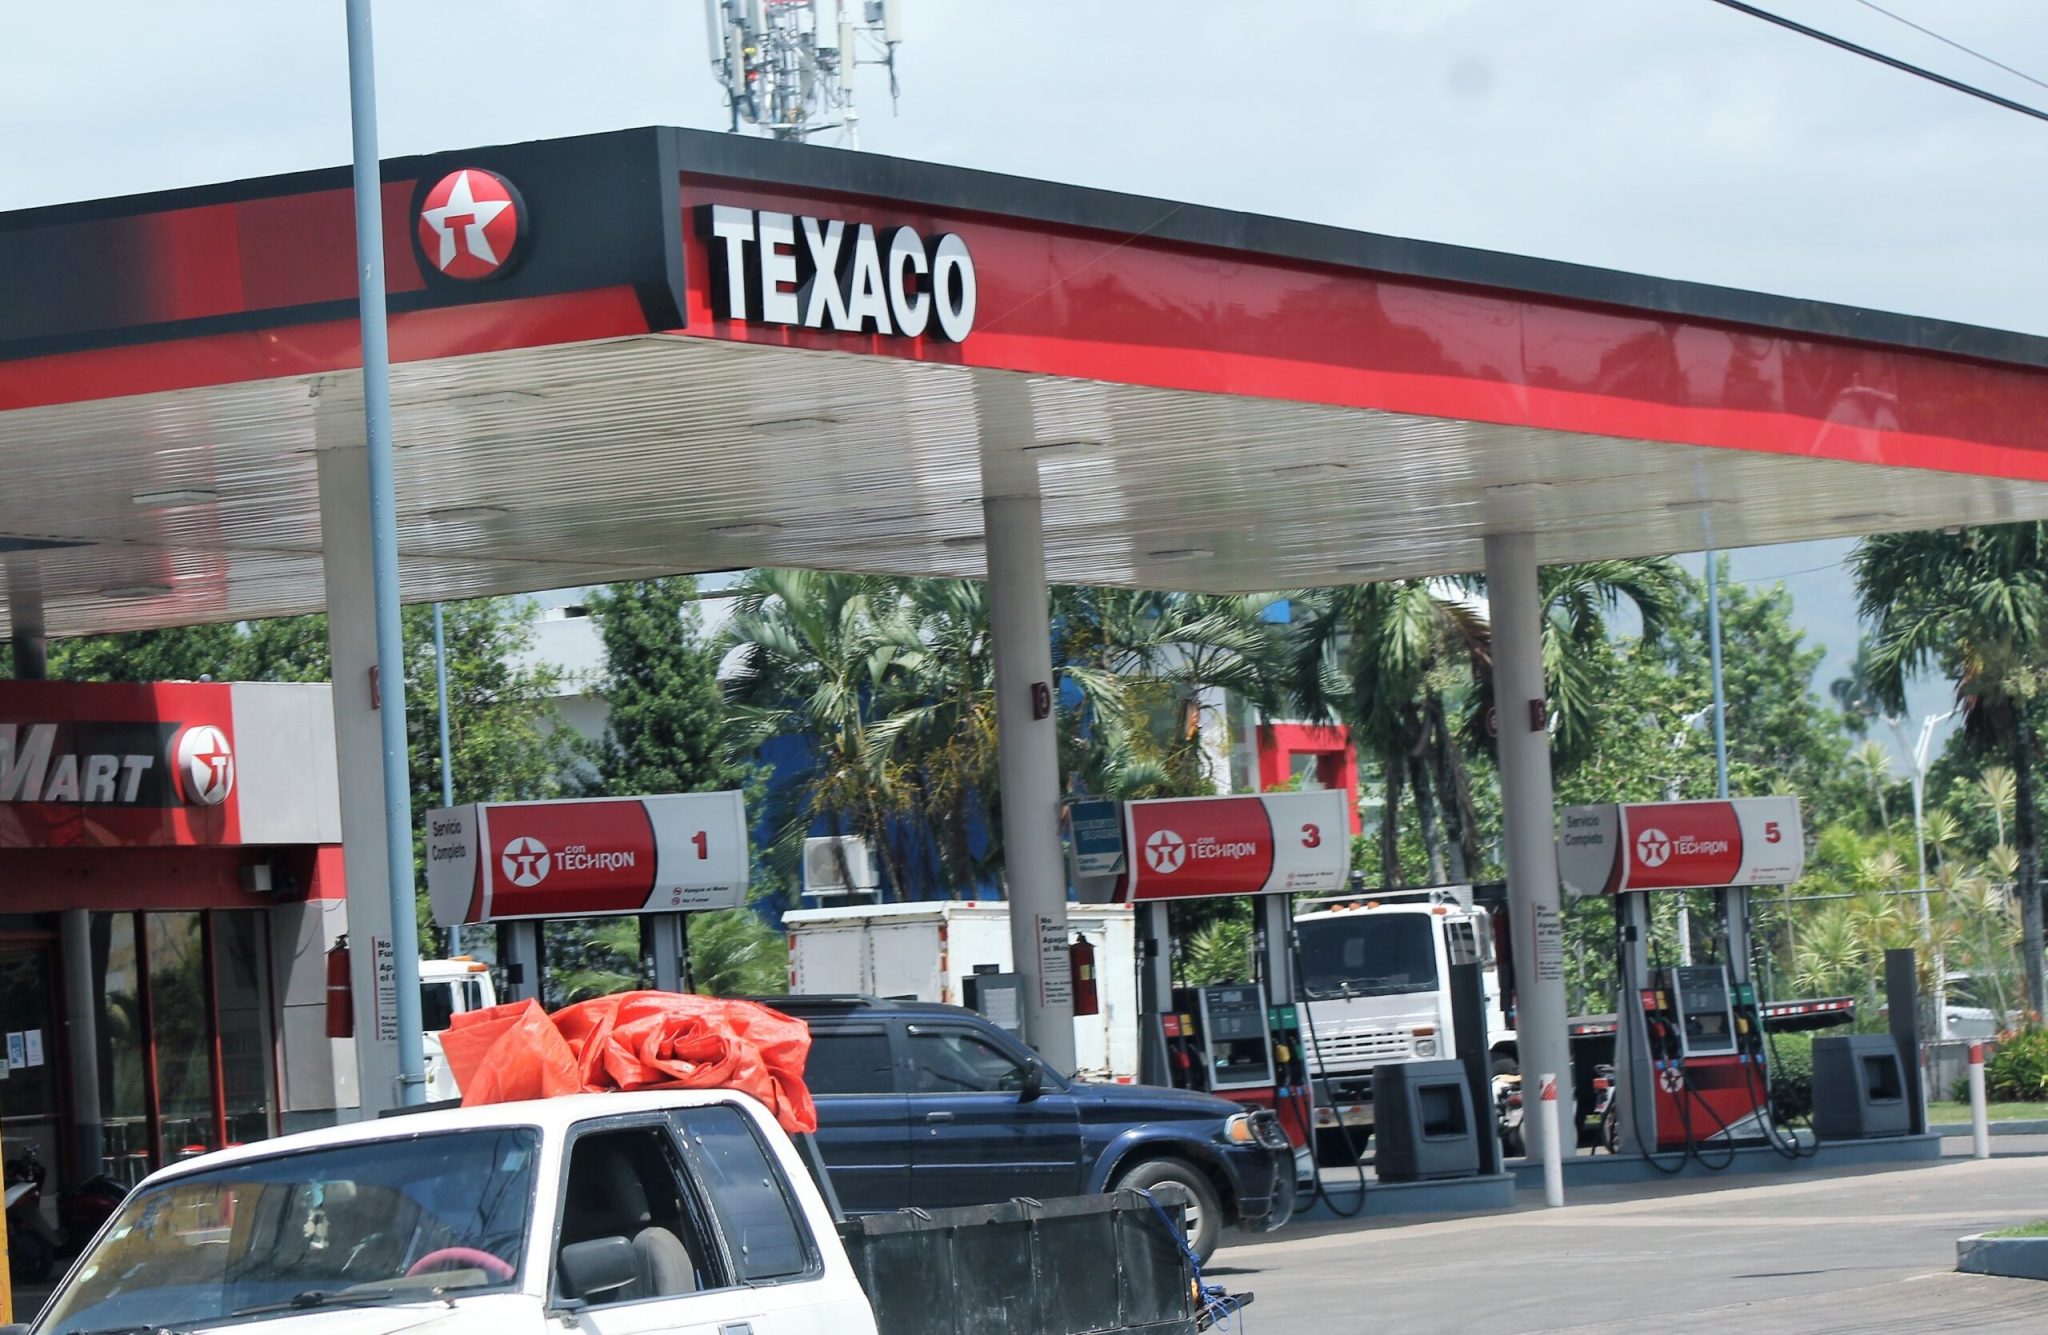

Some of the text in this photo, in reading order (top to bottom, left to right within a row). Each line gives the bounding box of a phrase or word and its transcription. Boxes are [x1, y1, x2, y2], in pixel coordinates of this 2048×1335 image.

[711, 203, 977, 344] TEXACO
[432, 818, 463, 837] Servicio
[1566, 814, 1600, 829] Servicio
[1301, 823, 1322, 849] 3
[1564, 833, 1604, 849] Completo
[1764, 822, 1782, 844] 5
[432, 842, 467, 863] Completo
[564, 845, 587, 855] con
[691, 831, 708, 860] 1
[1187, 842, 1257, 860] TECHRON
[1672, 840, 1729, 856] TECHRON
[554, 852, 636, 872] TECHRON
[378, 941, 391, 949] No
